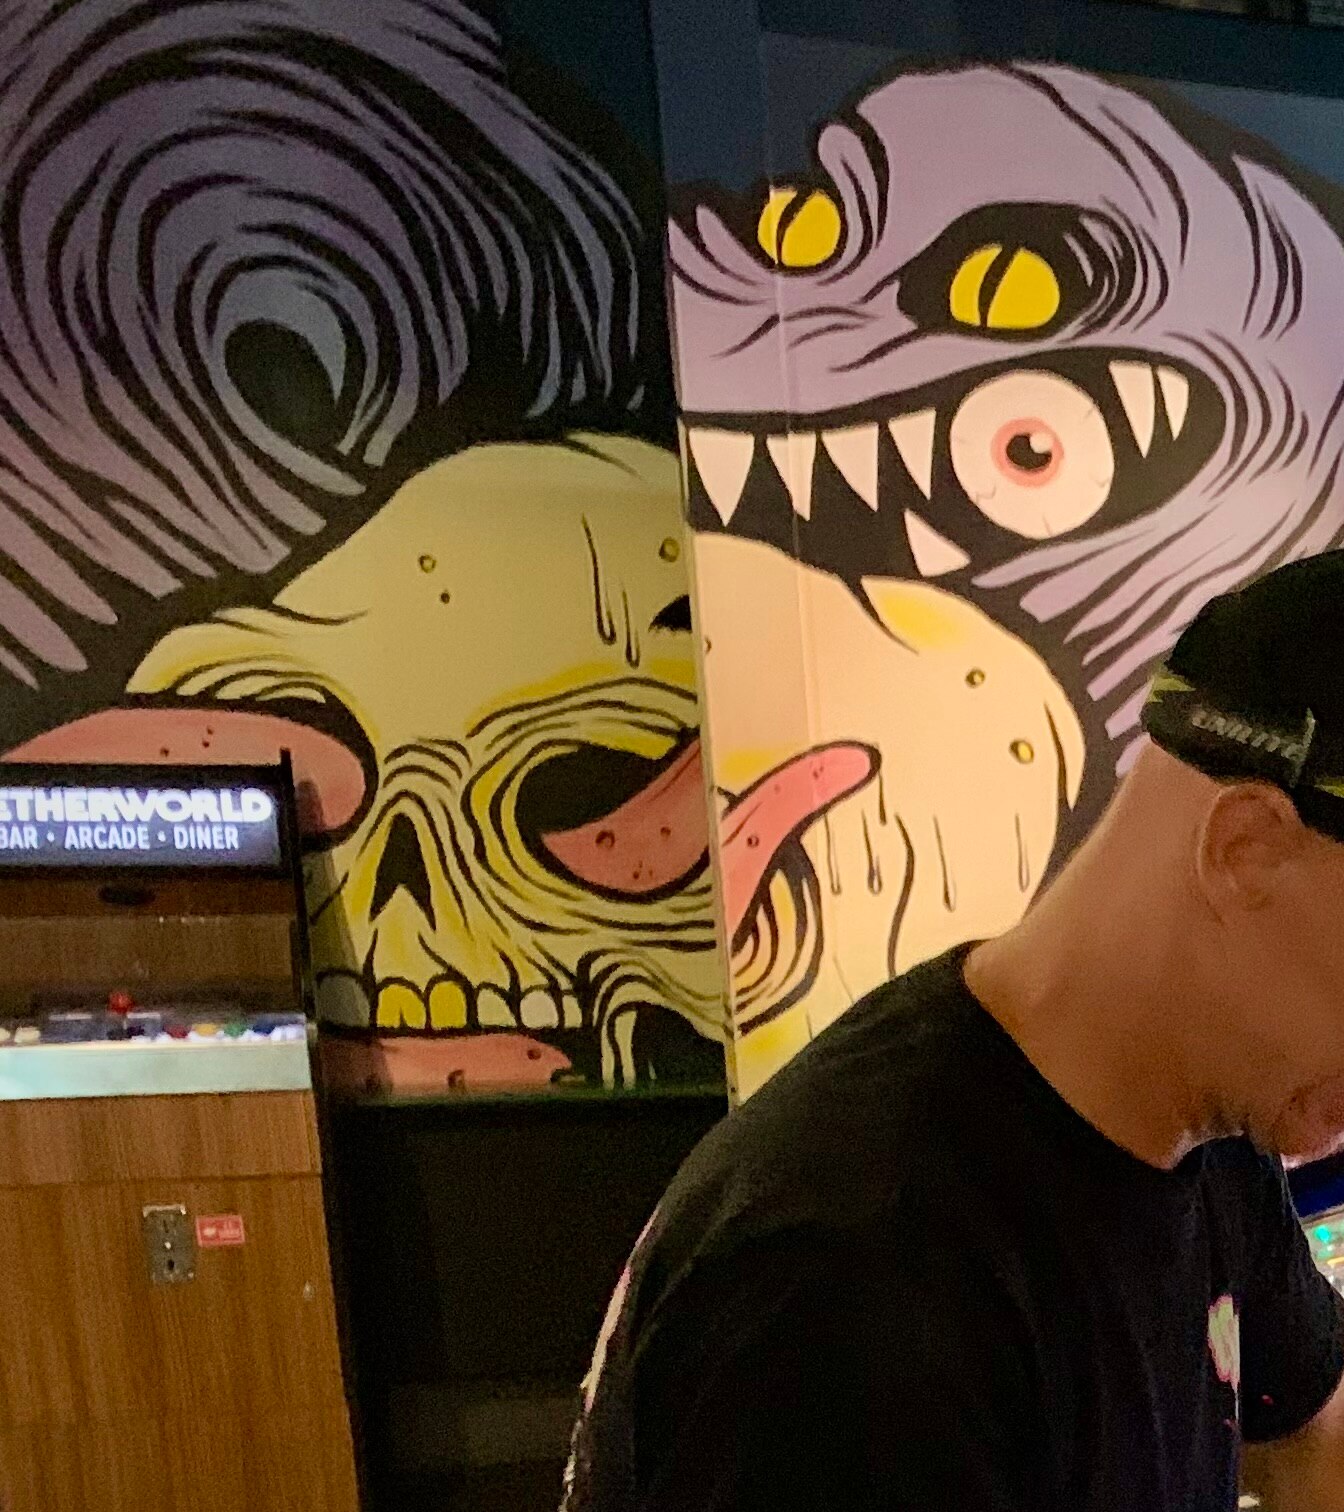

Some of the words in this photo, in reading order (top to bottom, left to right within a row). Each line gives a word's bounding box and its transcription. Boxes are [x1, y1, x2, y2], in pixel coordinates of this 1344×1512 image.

[0, 824, 39, 849] BAR
[64, 824, 150, 850] ARCADE
[173, 824, 240, 850] DINER
